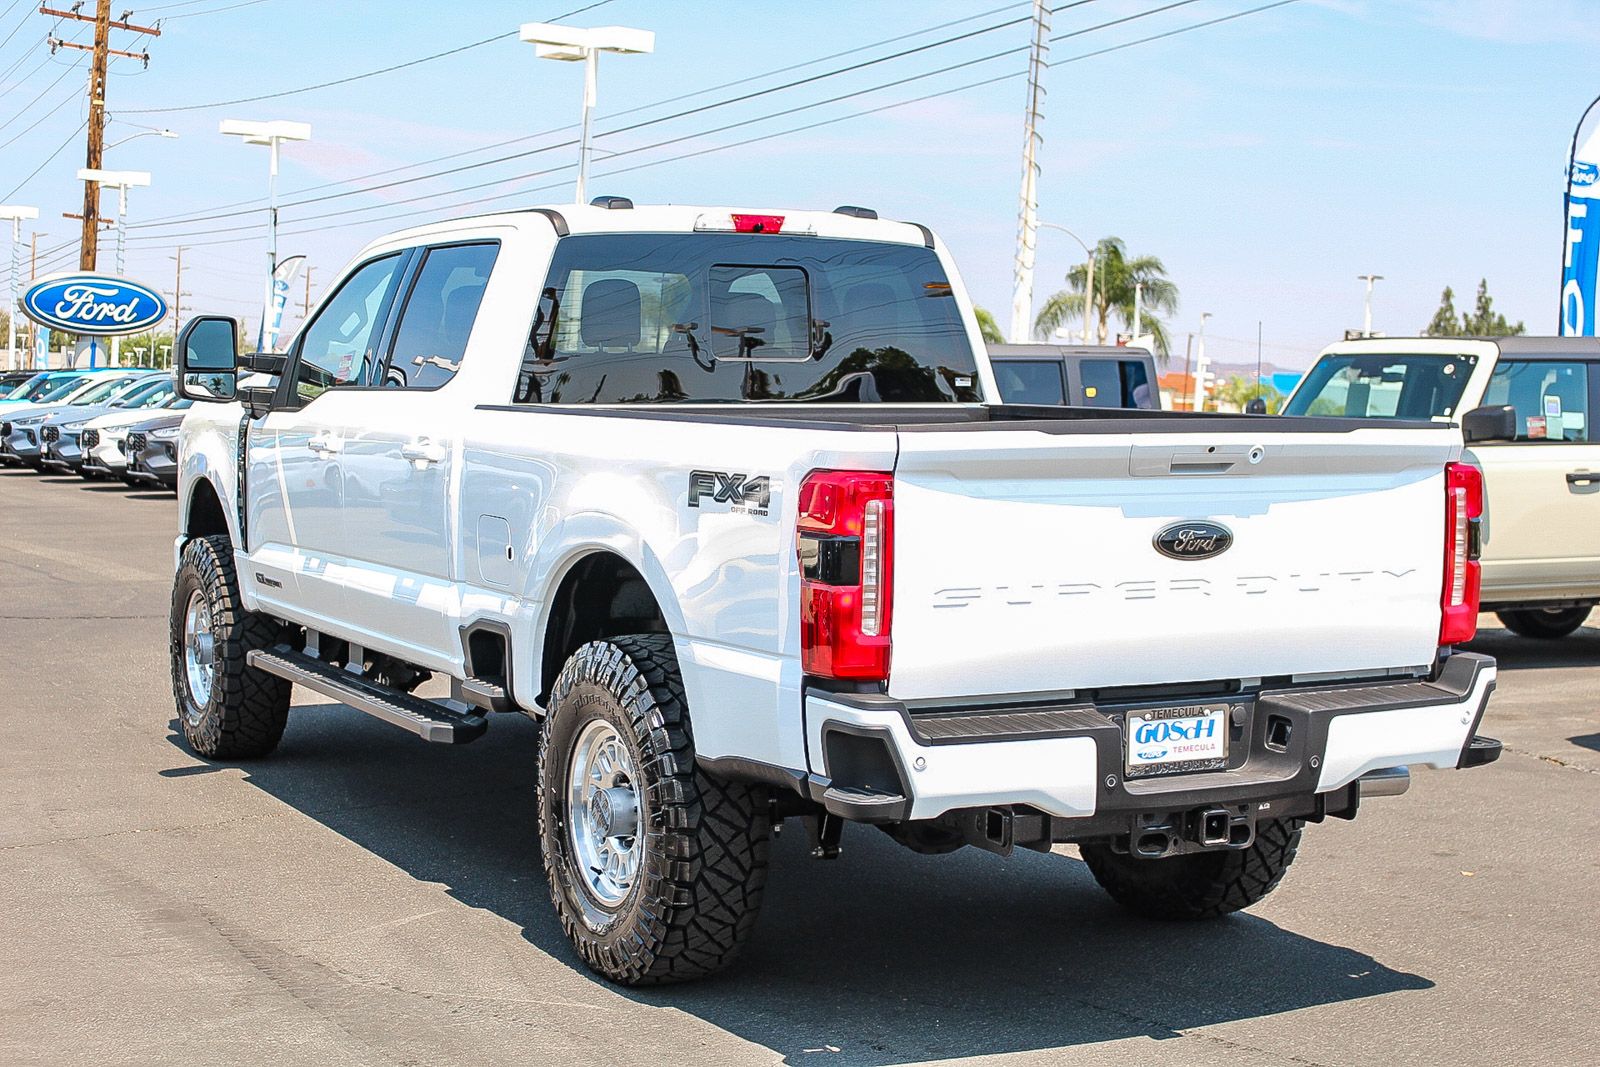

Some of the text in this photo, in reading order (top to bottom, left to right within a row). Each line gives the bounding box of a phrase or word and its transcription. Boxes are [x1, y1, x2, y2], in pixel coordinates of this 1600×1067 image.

[55, 285, 139, 323] Ford
[688, 469, 770, 508] FX4
[730, 506, 769, 517] OFF ROAD
[1173, 529, 1217, 552] Ford
[1151, 706, 1205, 720] TEMECULA
[1172, 743, 1216, 753] TEMECULA
